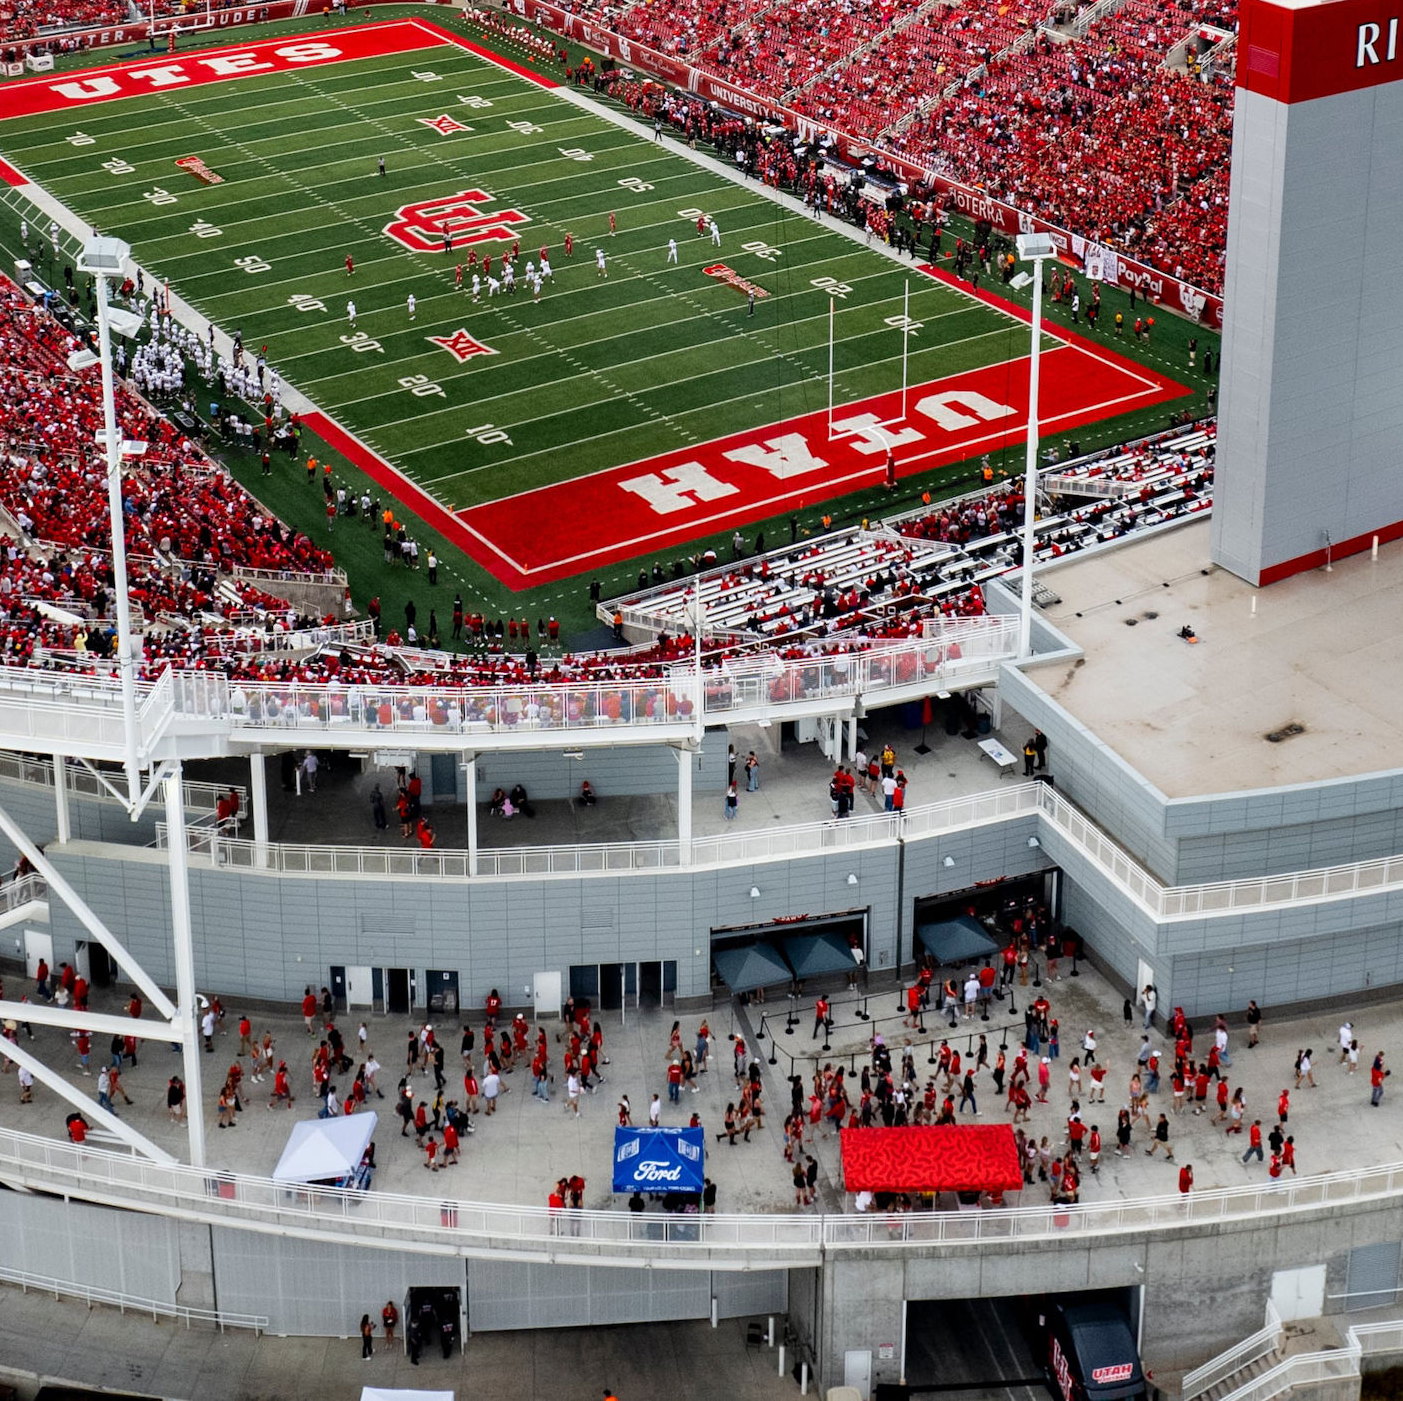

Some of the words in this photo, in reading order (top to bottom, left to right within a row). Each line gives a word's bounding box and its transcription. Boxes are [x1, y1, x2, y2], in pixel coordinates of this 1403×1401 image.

[50, 42, 344, 100] UTES
[710, 83, 770, 117] UNIVERSITY
[510, 120, 544, 135] 30
[66, 132, 96, 147] 10
[561, 146, 595, 162] 40
[102, 157, 136, 174] 20
[617, 176, 655, 193] 50
[143, 186, 178, 206] 30
[188, 220, 223, 238] 40
[741, 241, 782, 259] 30
[233, 255, 271, 274] 50
[810, 276, 852, 295] 20
[287, 294, 322, 313] 40
[339, 331, 381, 353] 30
[397, 374, 442, 398] 20
[466, 423, 510, 446] 10
[617, 391, 1018, 515] UTAH
[633, 1160, 682, 1181] Ford
[1092, 1363, 1133, 1380] UTAH
